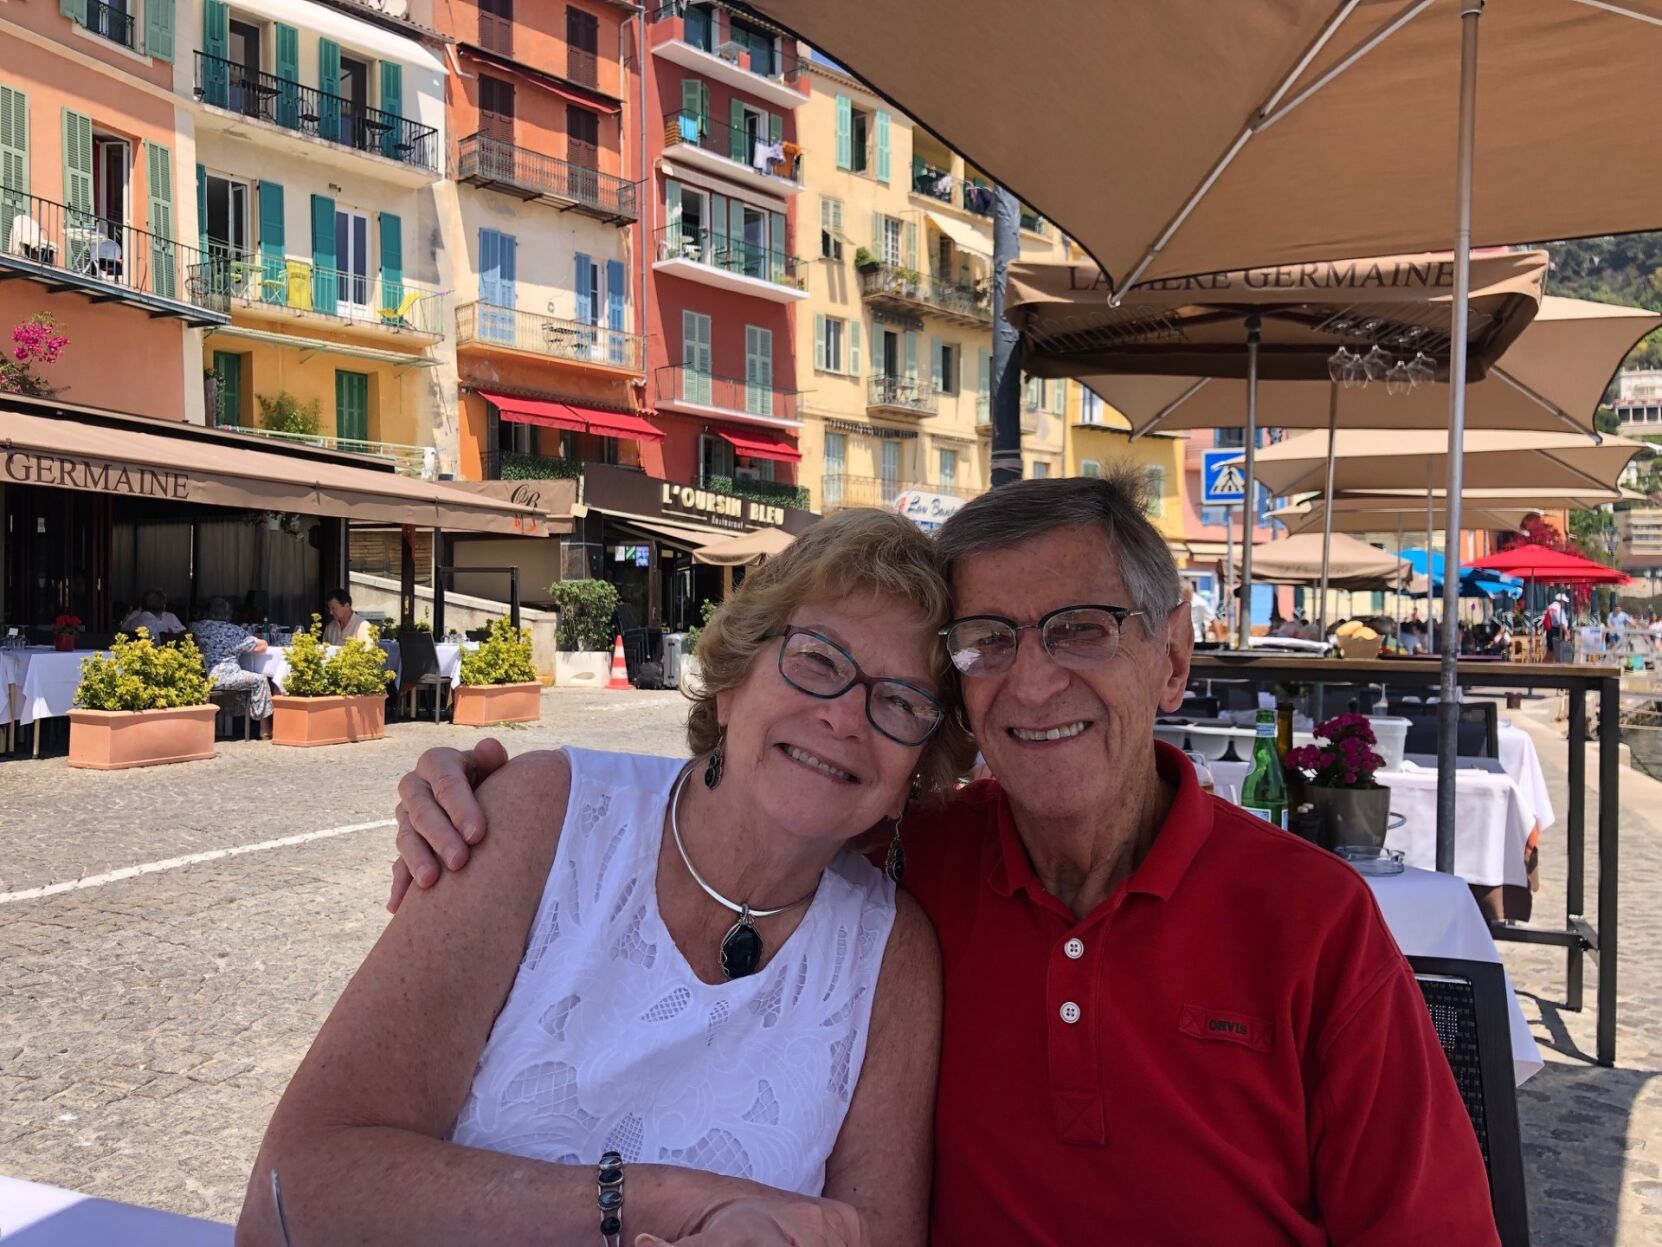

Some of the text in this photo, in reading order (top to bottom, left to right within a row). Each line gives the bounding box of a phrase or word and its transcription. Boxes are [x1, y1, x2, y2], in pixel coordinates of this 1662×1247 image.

[1243, 261, 1454, 290] GERMAINE
[5, 452, 190, 500] GERMAINE
[662, 483, 785, 526] L'OURSIN BLEU
[1208, 1018, 1249, 1035] ORVIS
